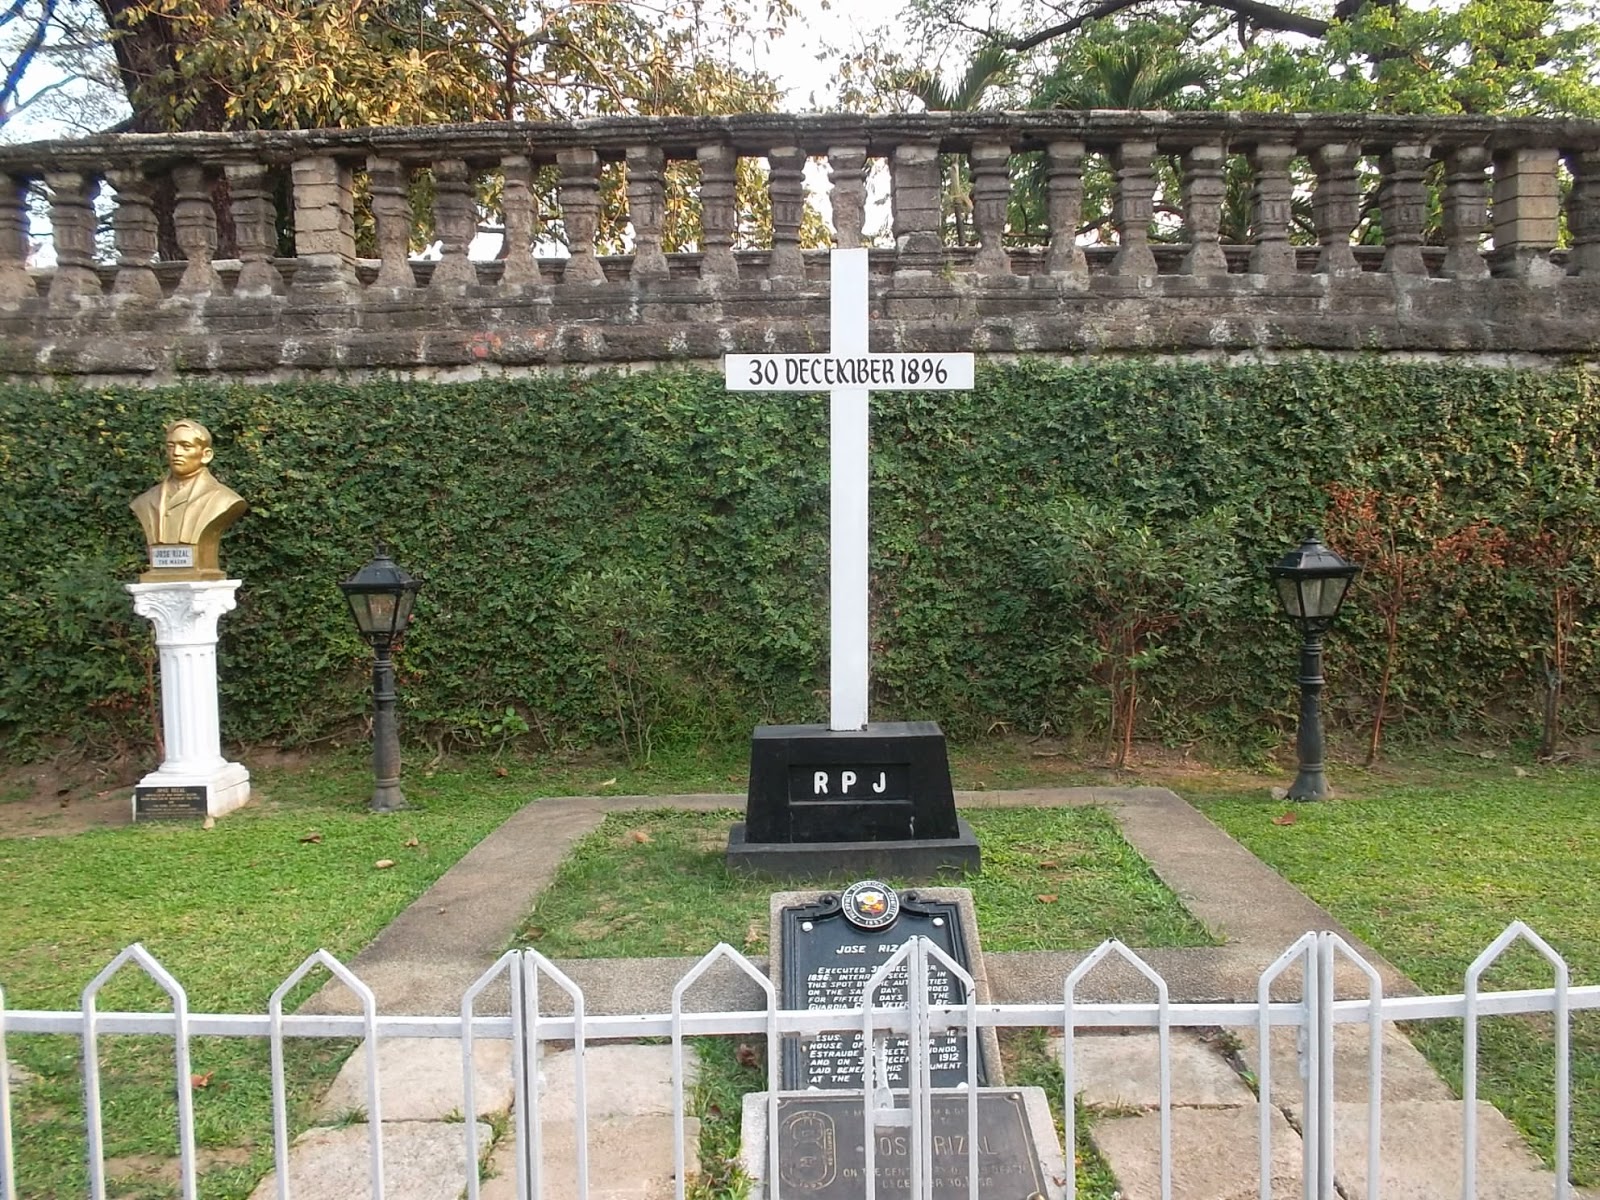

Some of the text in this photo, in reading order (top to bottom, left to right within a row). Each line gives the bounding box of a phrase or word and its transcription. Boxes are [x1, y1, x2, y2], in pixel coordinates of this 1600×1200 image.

[749, 358, 948, 385] 30 DECEMBER 1896
[155, 549, 190, 558] JOSE RIZAL
[836, 944, 902, 954] JOSE RIZ
[838, 973, 872, 981] INTERR
[808, 981, 827, 989] THIS
[809, 1042, 843, 1050] HOUSE
[809, 1050, 859, 1058] ESTRAUDE
[810, 1058, 830, 1066] AND
[939, 1053, 960, 1062] 1912
[809, 1075, 824, 1083] AT
[843, 1168, 858, 1177] ON
